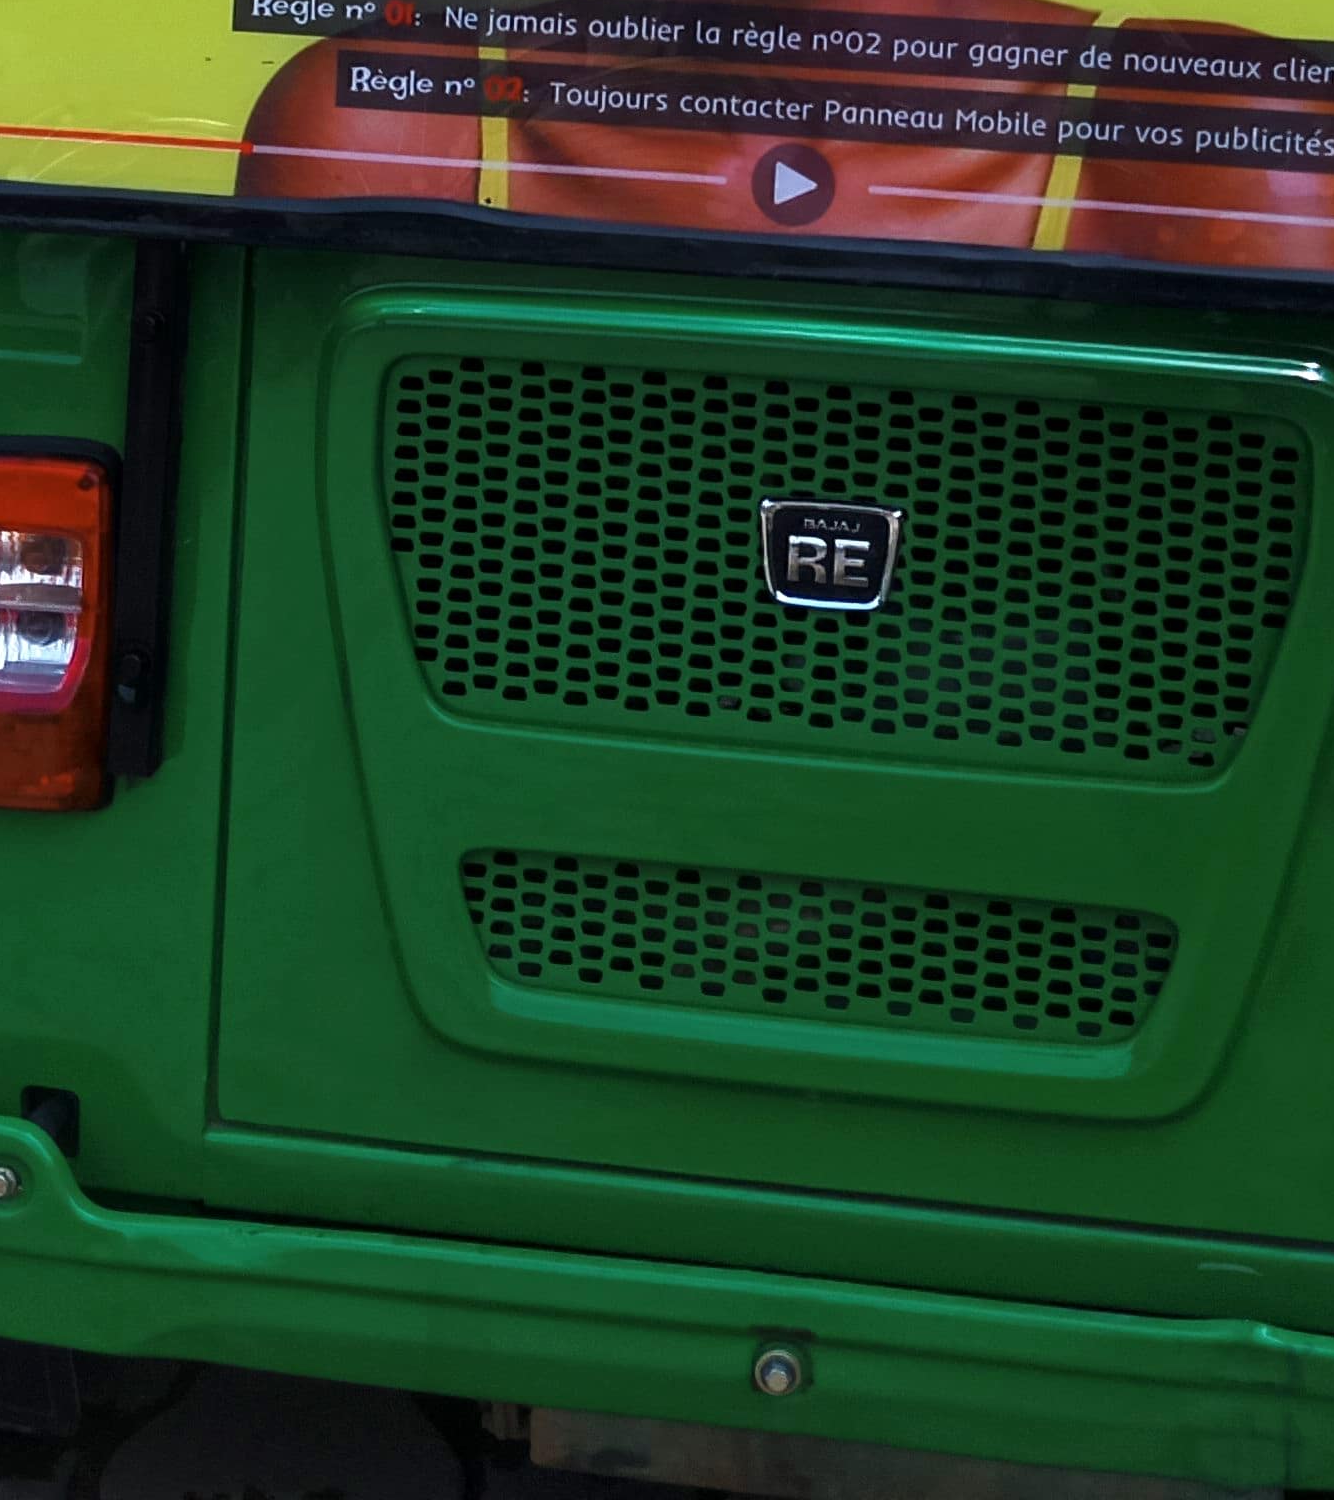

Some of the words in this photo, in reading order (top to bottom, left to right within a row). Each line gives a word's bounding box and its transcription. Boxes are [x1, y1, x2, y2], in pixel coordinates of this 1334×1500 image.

[444, 6, 479, 31] Ne
[485, 7, 578, 38] jamais
[588, 13, 683, 43] oublier
[695, 20, 722, 46] la
[732, 22, 802, 54] règle
[892, 37, 959, 62] pour
[968, 39, 1069, 70] gagner
[1079, 45, 1113, 71] de
[1123, 52, 1263, 80] nouveaux
[349, 66, 434, 101] Règle
[550, 80, 668, 114] Toujours
[679, 92, 815, 123] contacter
[824, 100, 944, 131] Panneau
[955, 108, 1047, 138] Mobile
[1057, 120, 1125, 145] pour
[1135, 124, 1184, 147] vos
[803, 517, 862, 534] BAJAJ
[786, 534, 872, 589] RE
